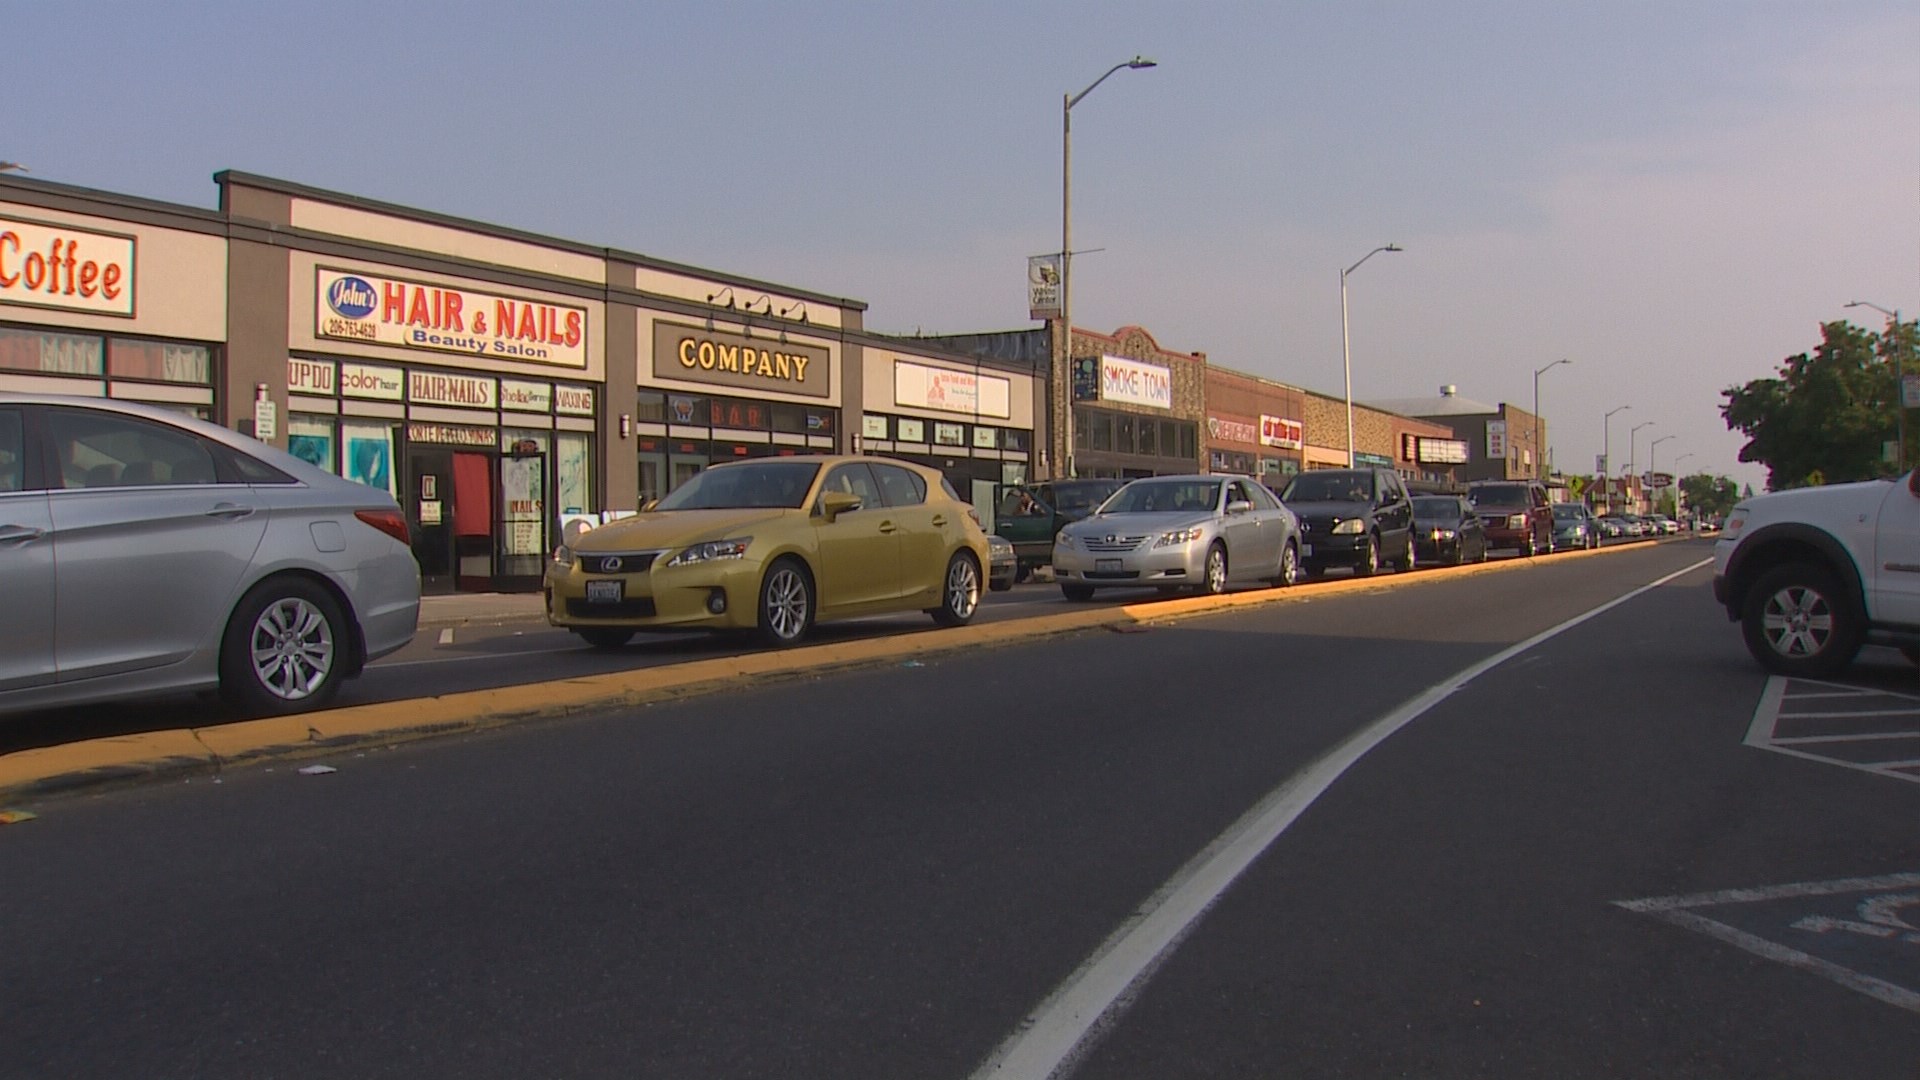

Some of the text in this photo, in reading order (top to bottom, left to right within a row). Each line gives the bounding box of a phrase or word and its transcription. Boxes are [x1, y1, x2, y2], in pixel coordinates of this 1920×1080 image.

[0, 231, 121, 300] Coffee
[333, 279, 375, 308] John's
[381, 281, 581, 348] HAIR & NAILS
[412, 329, 547, 359] Beauty Salon
[679, 337, 809, 382] COMPANY
[340, 368, 379, 390] color
[412, 374, 488, 405] HAIR NAILS
[1103, 365, 1169, 400] SMOKE TOWN
[711, 400, 760, 427] BAR
